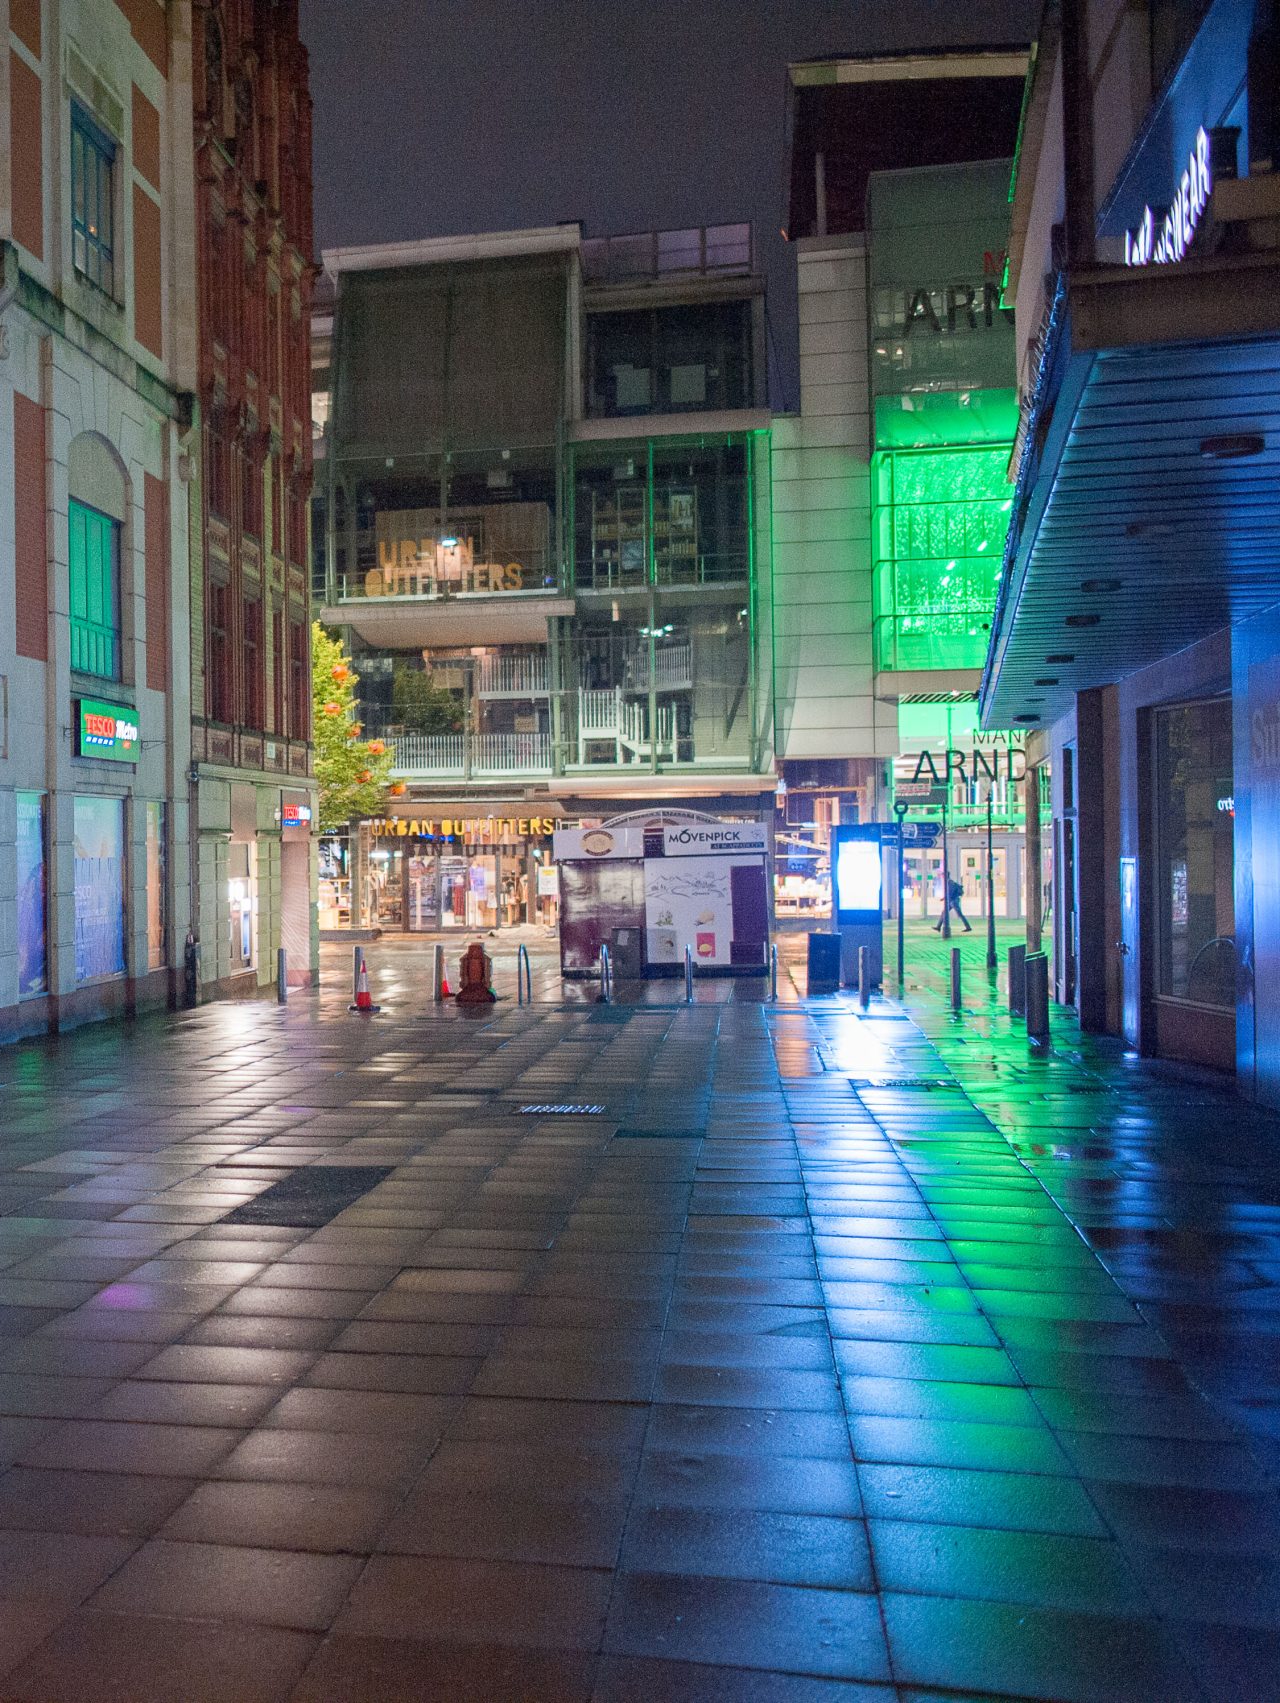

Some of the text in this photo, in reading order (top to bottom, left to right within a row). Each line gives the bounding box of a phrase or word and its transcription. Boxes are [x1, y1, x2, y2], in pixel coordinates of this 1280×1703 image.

[379, 537, 473, 568] URBN
[365, 562, 523, 597] OUTFTERS
[84, 714, 116, 738] TESCO
[371, 818, 554, 836] URBAN OUTFITTERS
